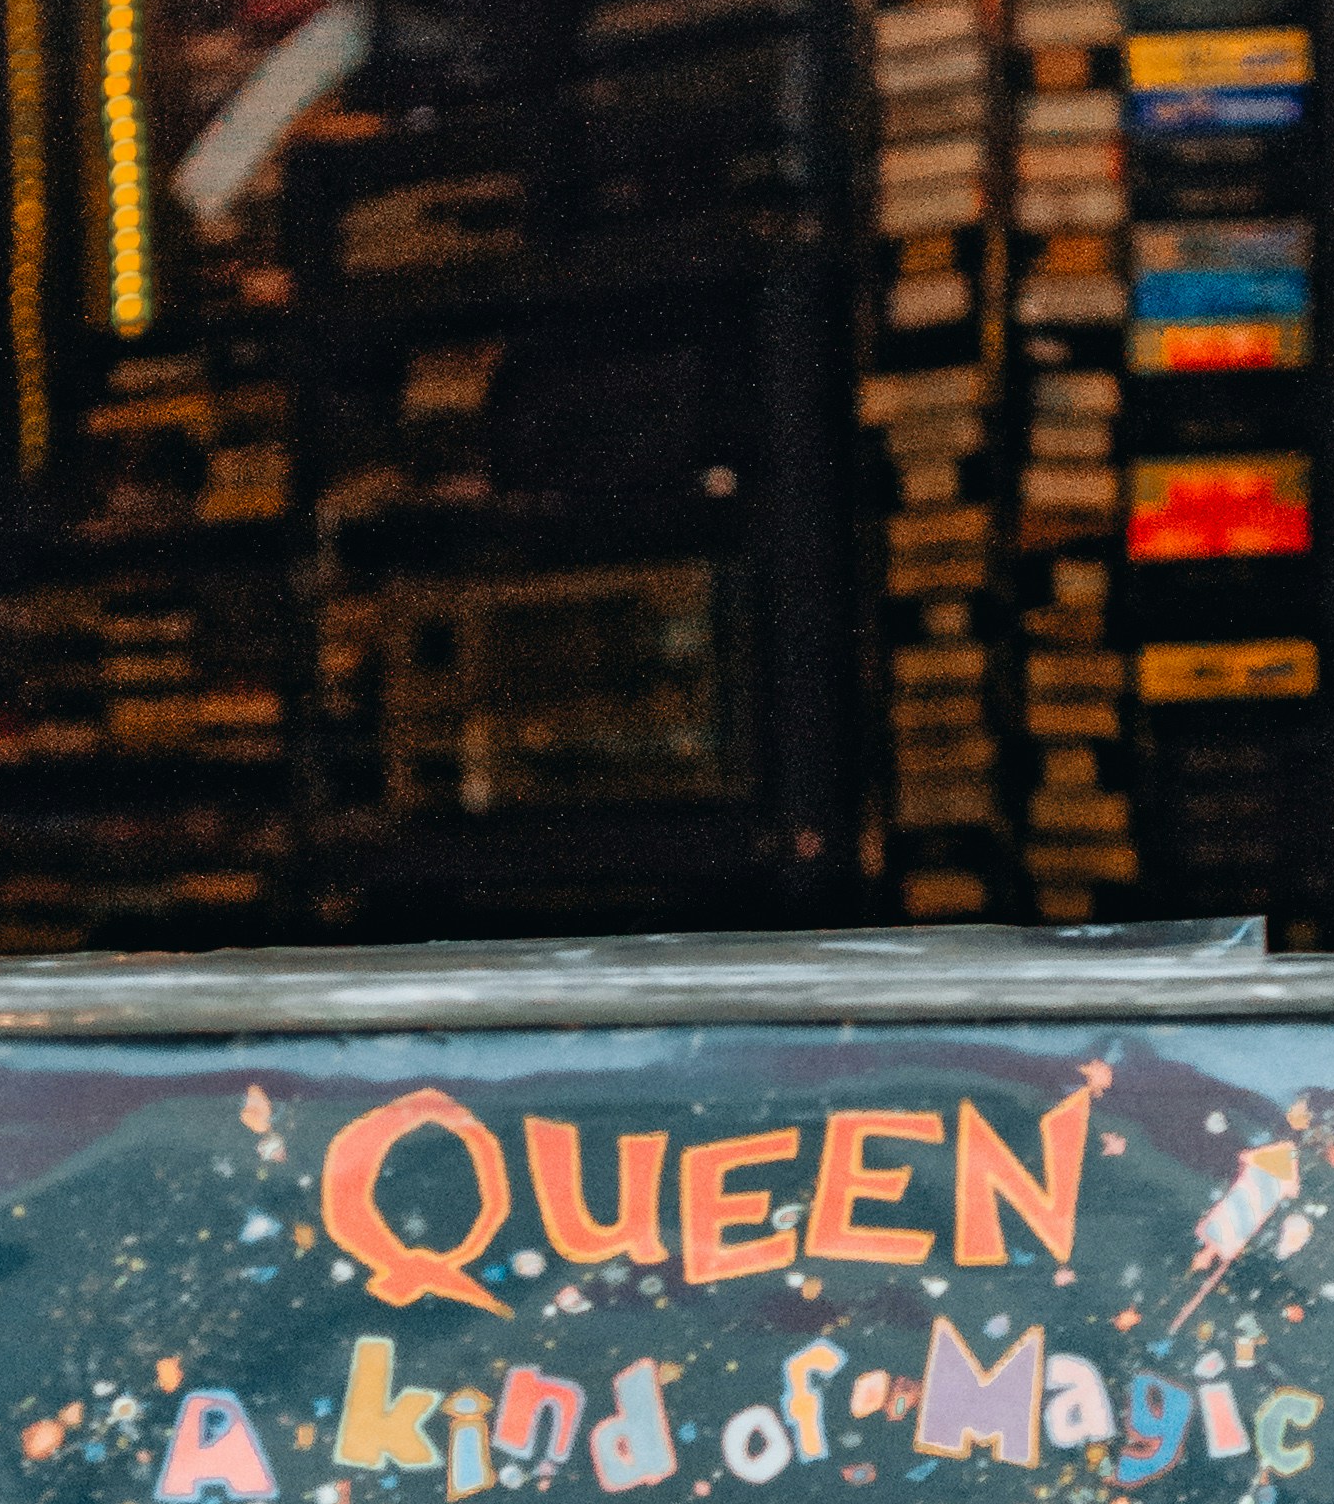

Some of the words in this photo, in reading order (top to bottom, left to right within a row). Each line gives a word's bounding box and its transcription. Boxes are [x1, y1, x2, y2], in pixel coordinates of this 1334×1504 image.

[320, 1086, 1093, 1320] QUEEN
[154, 1387, 280, 1504] A
[722, 1337, 848, 1484] of
[914, 1314, 1324, 1489] Magic
